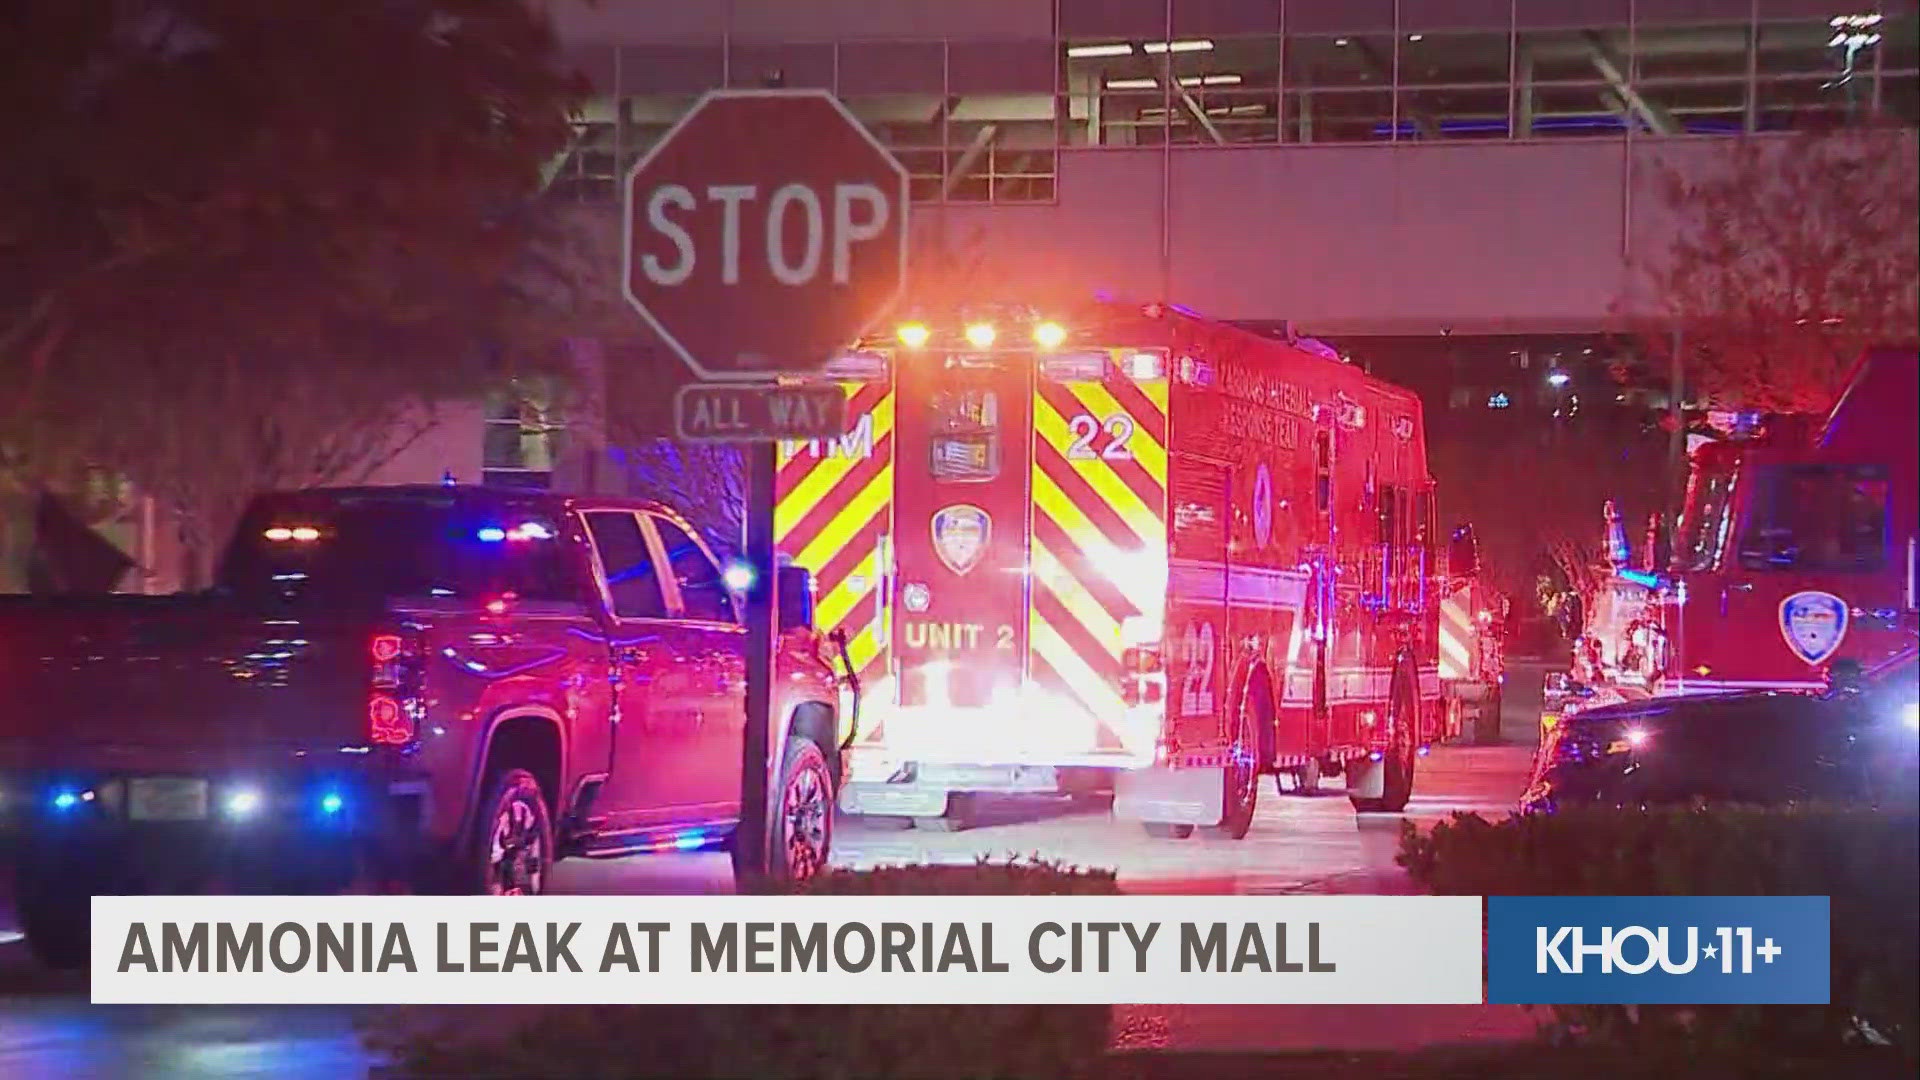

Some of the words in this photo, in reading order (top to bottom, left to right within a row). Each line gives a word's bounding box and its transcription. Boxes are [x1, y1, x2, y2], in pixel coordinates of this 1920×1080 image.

[641, 183, 890, 286] STOP
[692, 397, 751, 430] ALL
[767, 393, 833, 430] WAY
[1067, 413, 1134, 460] 22
[905, 622, 985, 650] UNIT
[992, 624, 1015, 650] 2
[1181, 621, 1214, 716] 22
